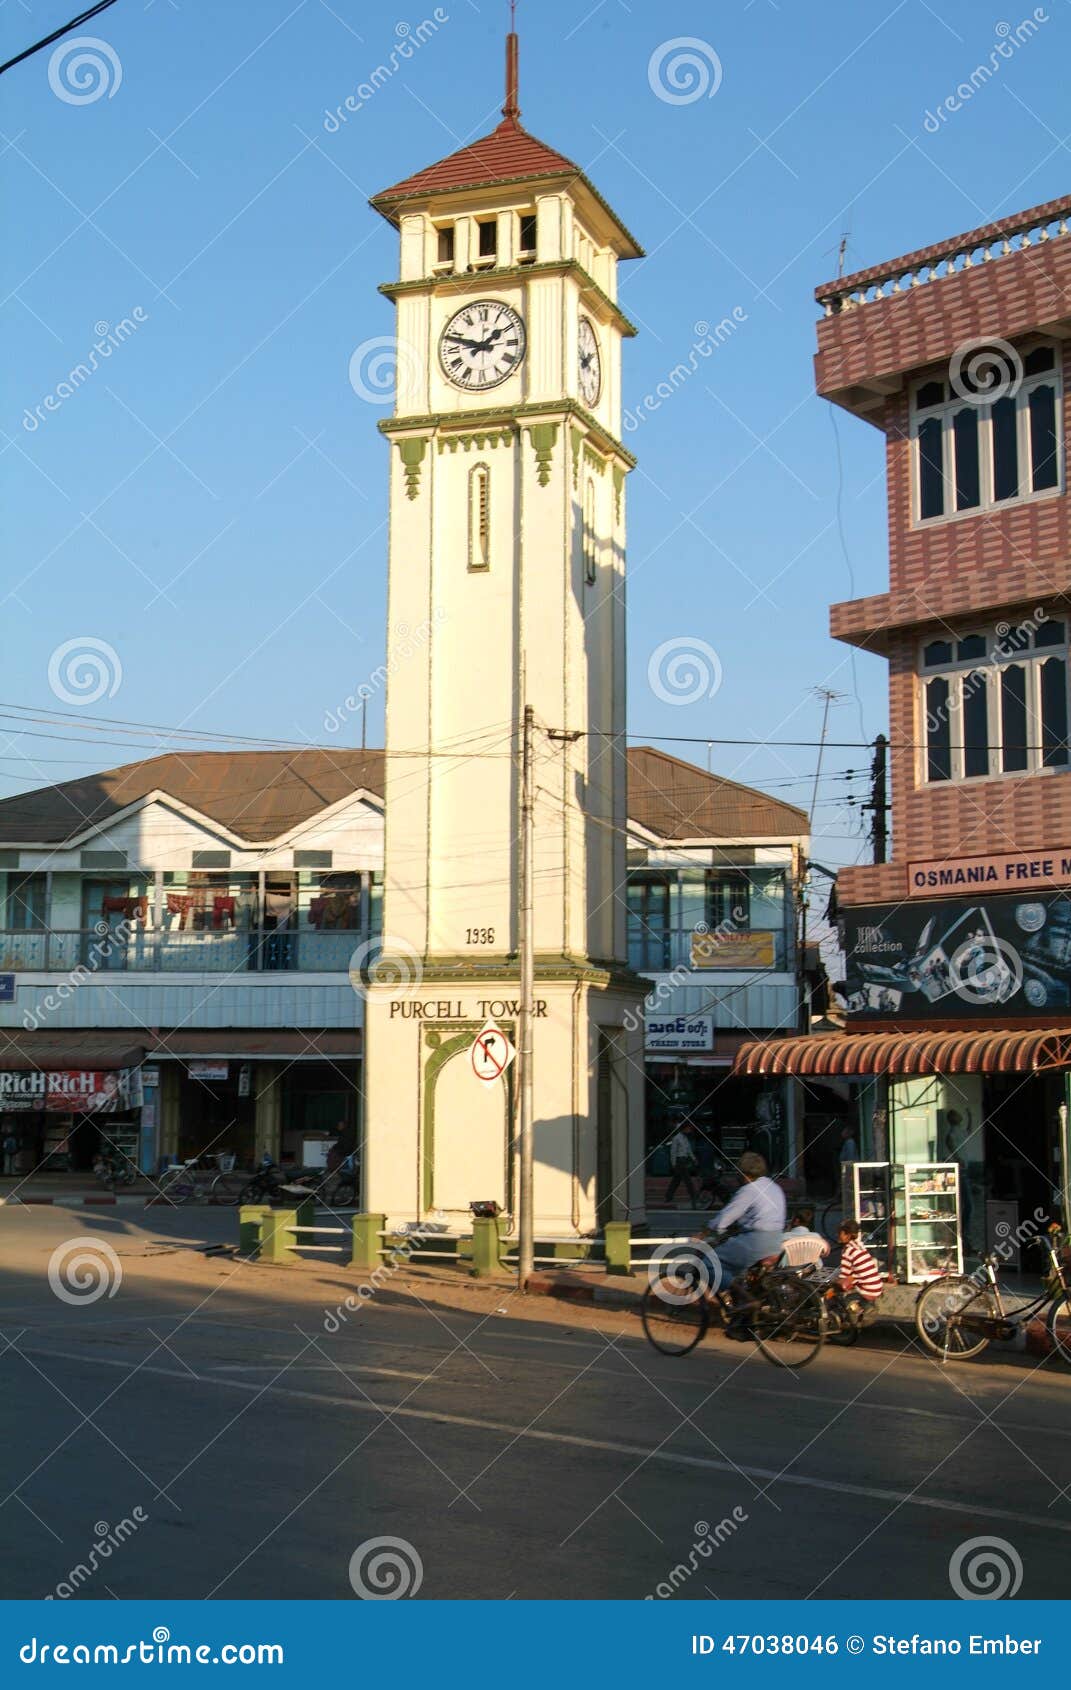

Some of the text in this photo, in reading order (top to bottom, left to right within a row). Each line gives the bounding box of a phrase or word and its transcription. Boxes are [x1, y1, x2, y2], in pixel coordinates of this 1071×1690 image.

[914, 865, 998, 887] OSMANIA
[1005, 860, 1054, 880] FREE
[466, 928, 496, 945] 1936
[854, 942, 903, 953] collection
[390, 1000, 548, 1019] PURCELL TOWR
